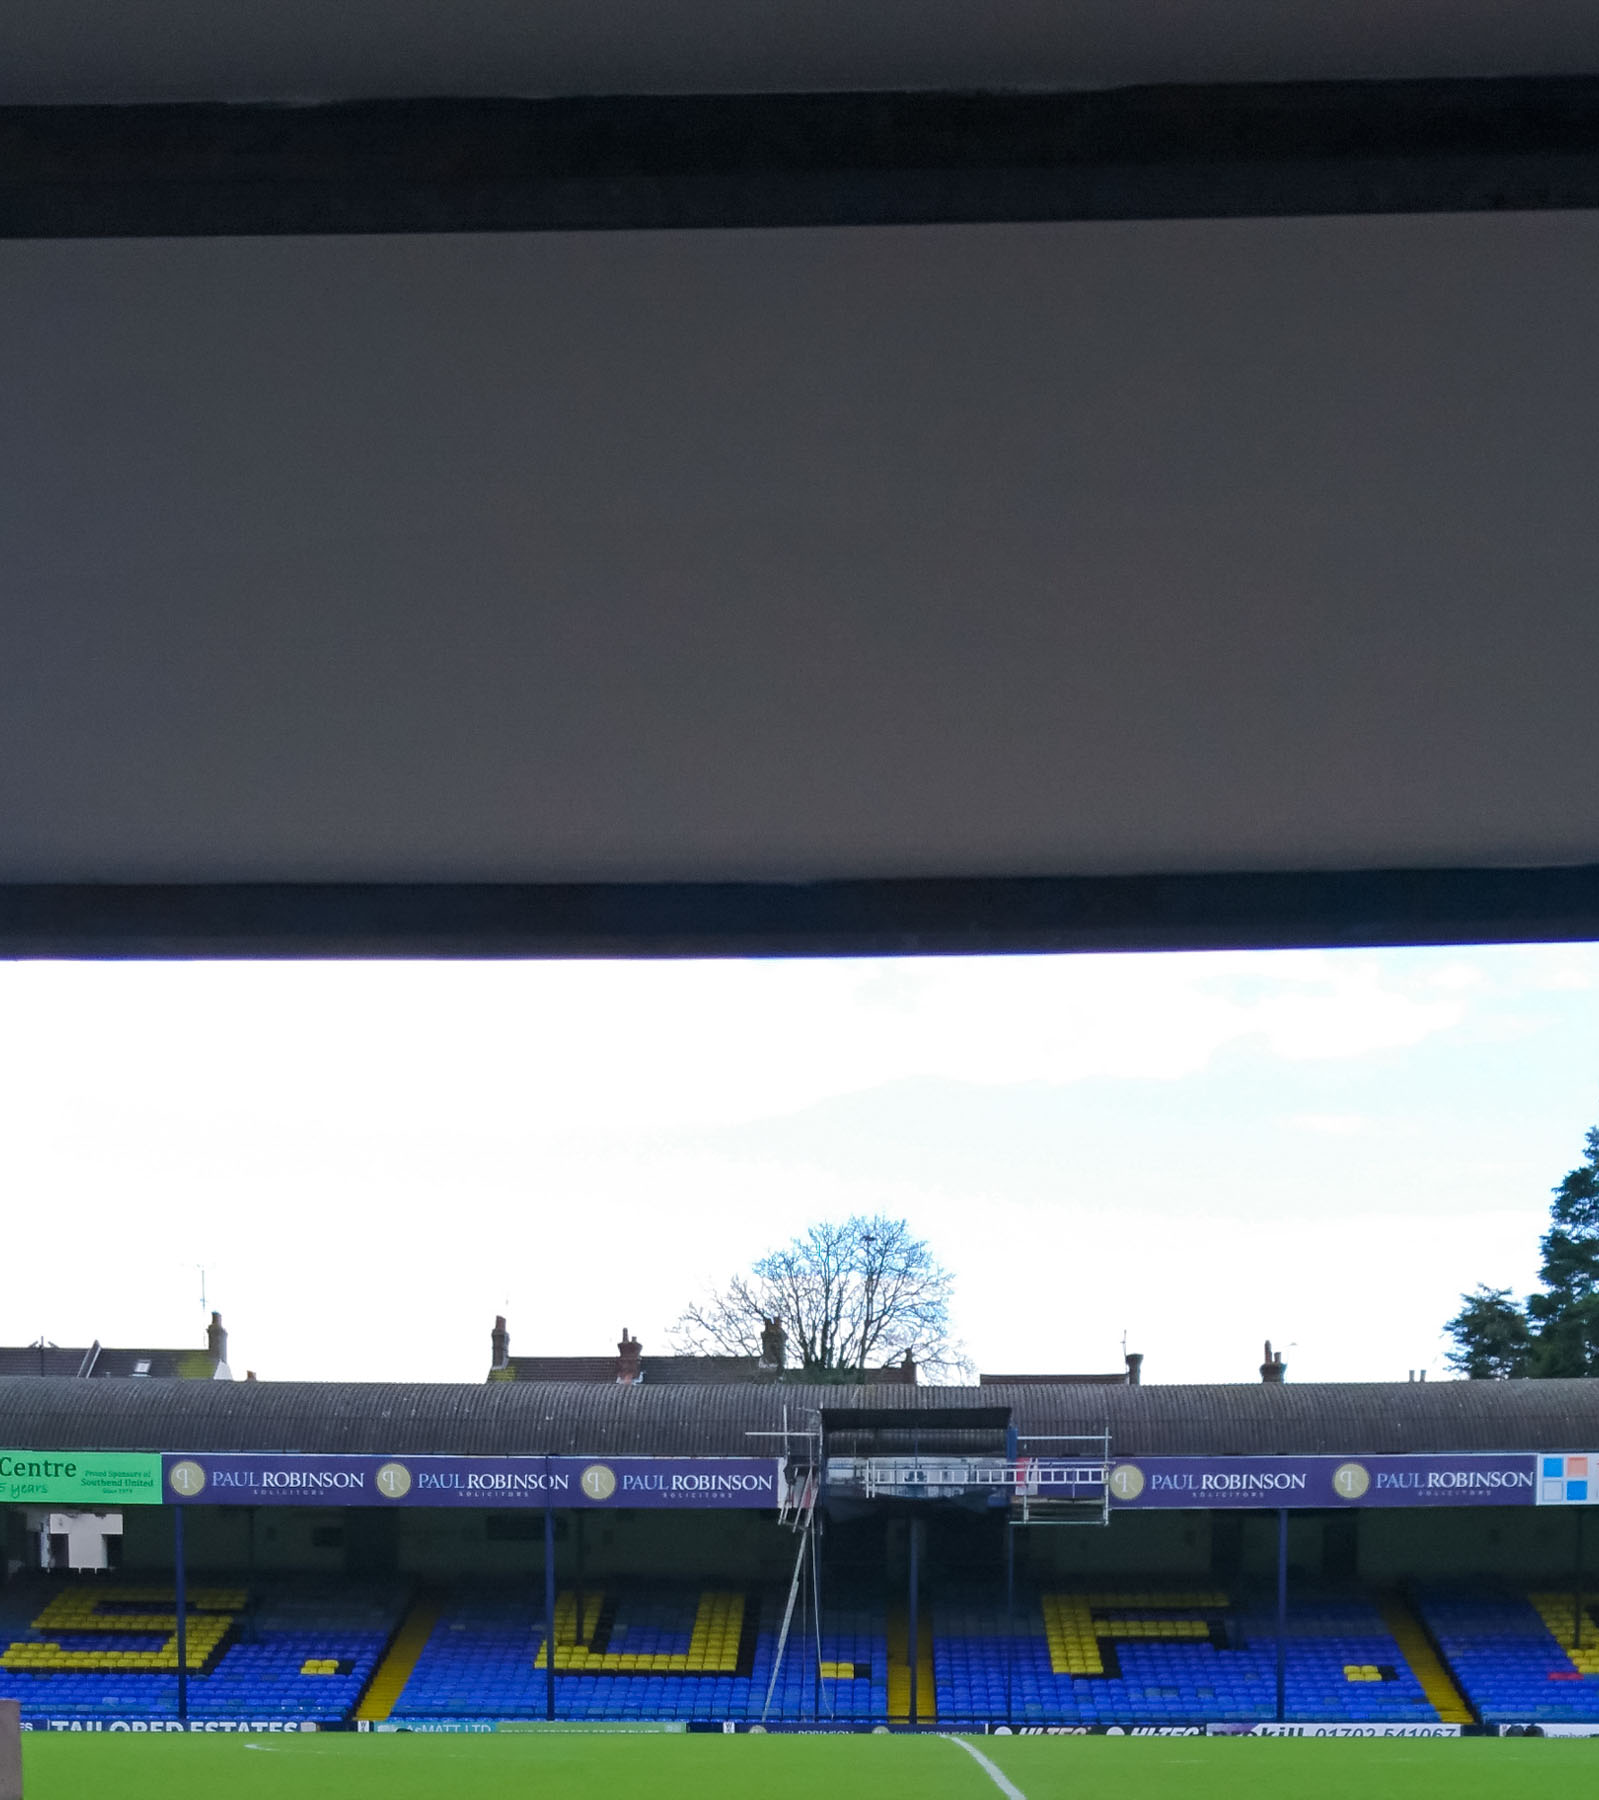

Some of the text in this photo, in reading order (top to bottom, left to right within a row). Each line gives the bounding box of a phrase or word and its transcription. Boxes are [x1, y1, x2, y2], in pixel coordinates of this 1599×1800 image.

[81, 1478, 123, 1488] Southend
[212, 1471, 365, 1488] PAUL ROBINSON
[417, 1473, 569, 1490] PAUL ROBINSON
[622, 1474, 773, 1491] PAUL ROBINSON
[1151, 1473, 1308, 1490] PAUL ROBINSON
[1375, 1471, 1535, 1489] PAUL ROBINSON
[11, 1483, 49, 1500] years
